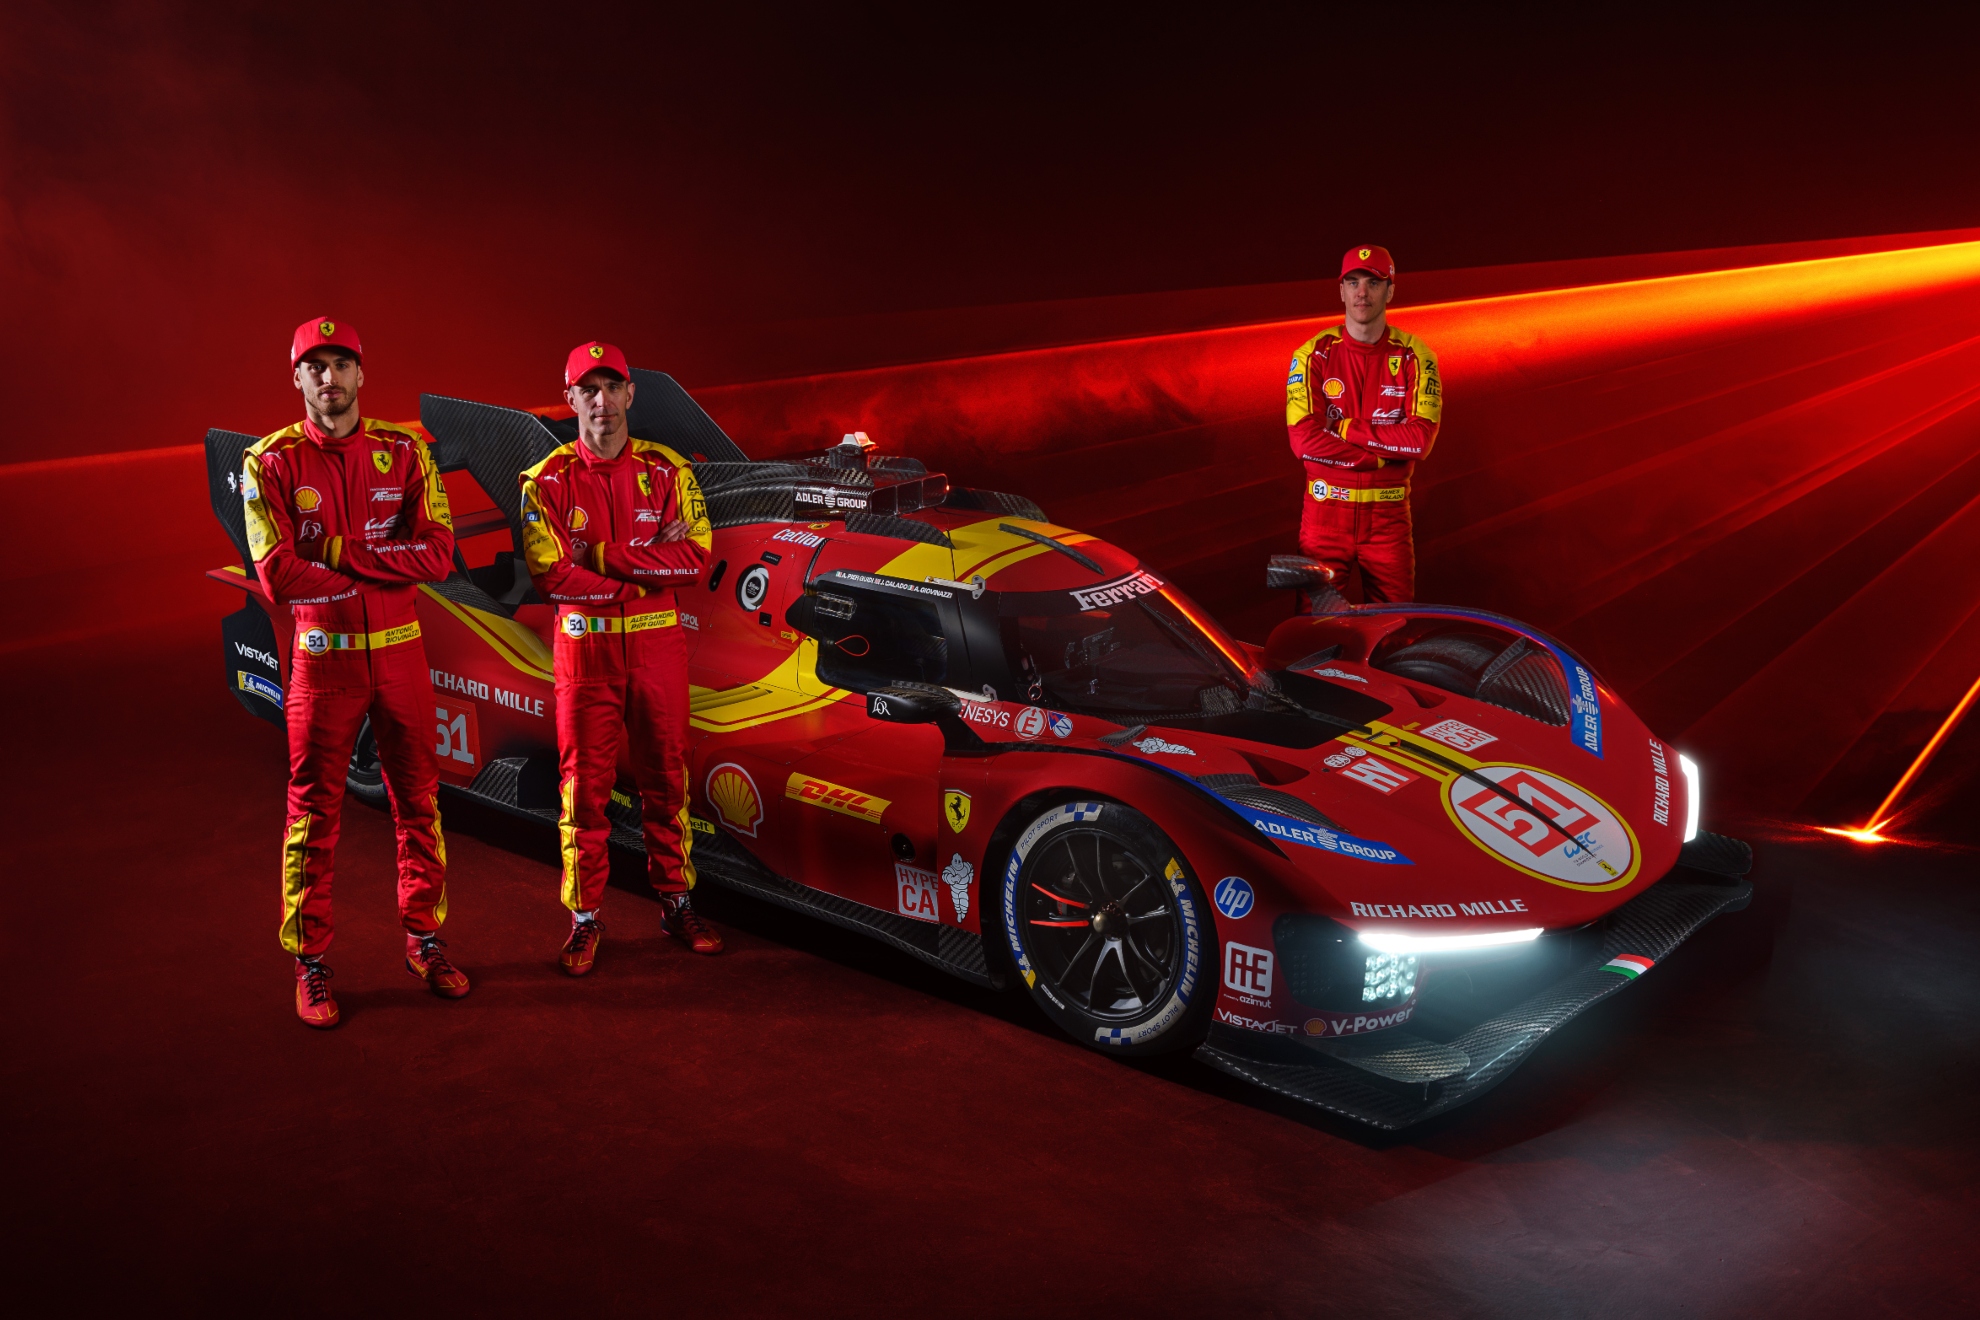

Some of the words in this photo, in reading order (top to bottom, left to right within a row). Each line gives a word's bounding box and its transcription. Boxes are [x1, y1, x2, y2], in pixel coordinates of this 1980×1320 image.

[1368, 441, 1398, 452] RICHARD
[795, 492, 824, 505] ADLER
[836, 497, 867, 509] GROUP
[1314, 484, 1326, 496] 51
[773, 528, 826, 549] Cetilar
[633, 568, 671, 576] RICHARD
[289, 595, 329, 605] RICHARD
[331, 589, 358, 602] MILLE
[590, 592, 615, 600] MILLE
[885, 580, 908, 590] CALADO
[920, 586, 953, 599] GIOVINAZZI
[1069, 569, 1165, 612] Ferrari
[569, 619, 585, 631] 51
[308, 634, 326, 647] 51
[234, 641, 279, 671] VISTAJET
[255, 682, 281, 701] MICHELIN
[430, 668, 489, 700] ICHARD
[494, 687, 545, 718] MILLE
[1575, 665, 1595, 702] GROUP
[436, 707, 475, 765] 51
[1443, 727, 1492, 749] CAR
[1584, 714, 1598, 752] ADLER
[1649, 738, 1669, 777] MILLE
[797, 780, 872, 815] DHL
[1653, 775, 1670, 827] RICHARD
[1474, 781, 1587, 847] 51
[1020, 828, 1036, 850] PILOT
[1036, 812, 1059, 831] SPORT
[1253, 818, 1317, 844] ADLER
[1338, 839, 1397, 861] GROUP
[902, 884, 938, 916] CA
[1003, 856, 1022, 953] MICHELIN
[1217, 876, 1251, 919] hp
[1350, 901, 1457, 919] RICHARD
[1458, 899, 1529, 917] MILLE
[1176, 898, 1199, 998] MICHELIN
[1161, 1004, 1179, 1026] PILOT
[1239, 994, 1272, 1009] azimut
[1137, 1022, 1161, 1039] SPORT
[1217, 1007, 1298, 1035] VISTAJET
[1331, 1007, 1413, 1037] V-Power
